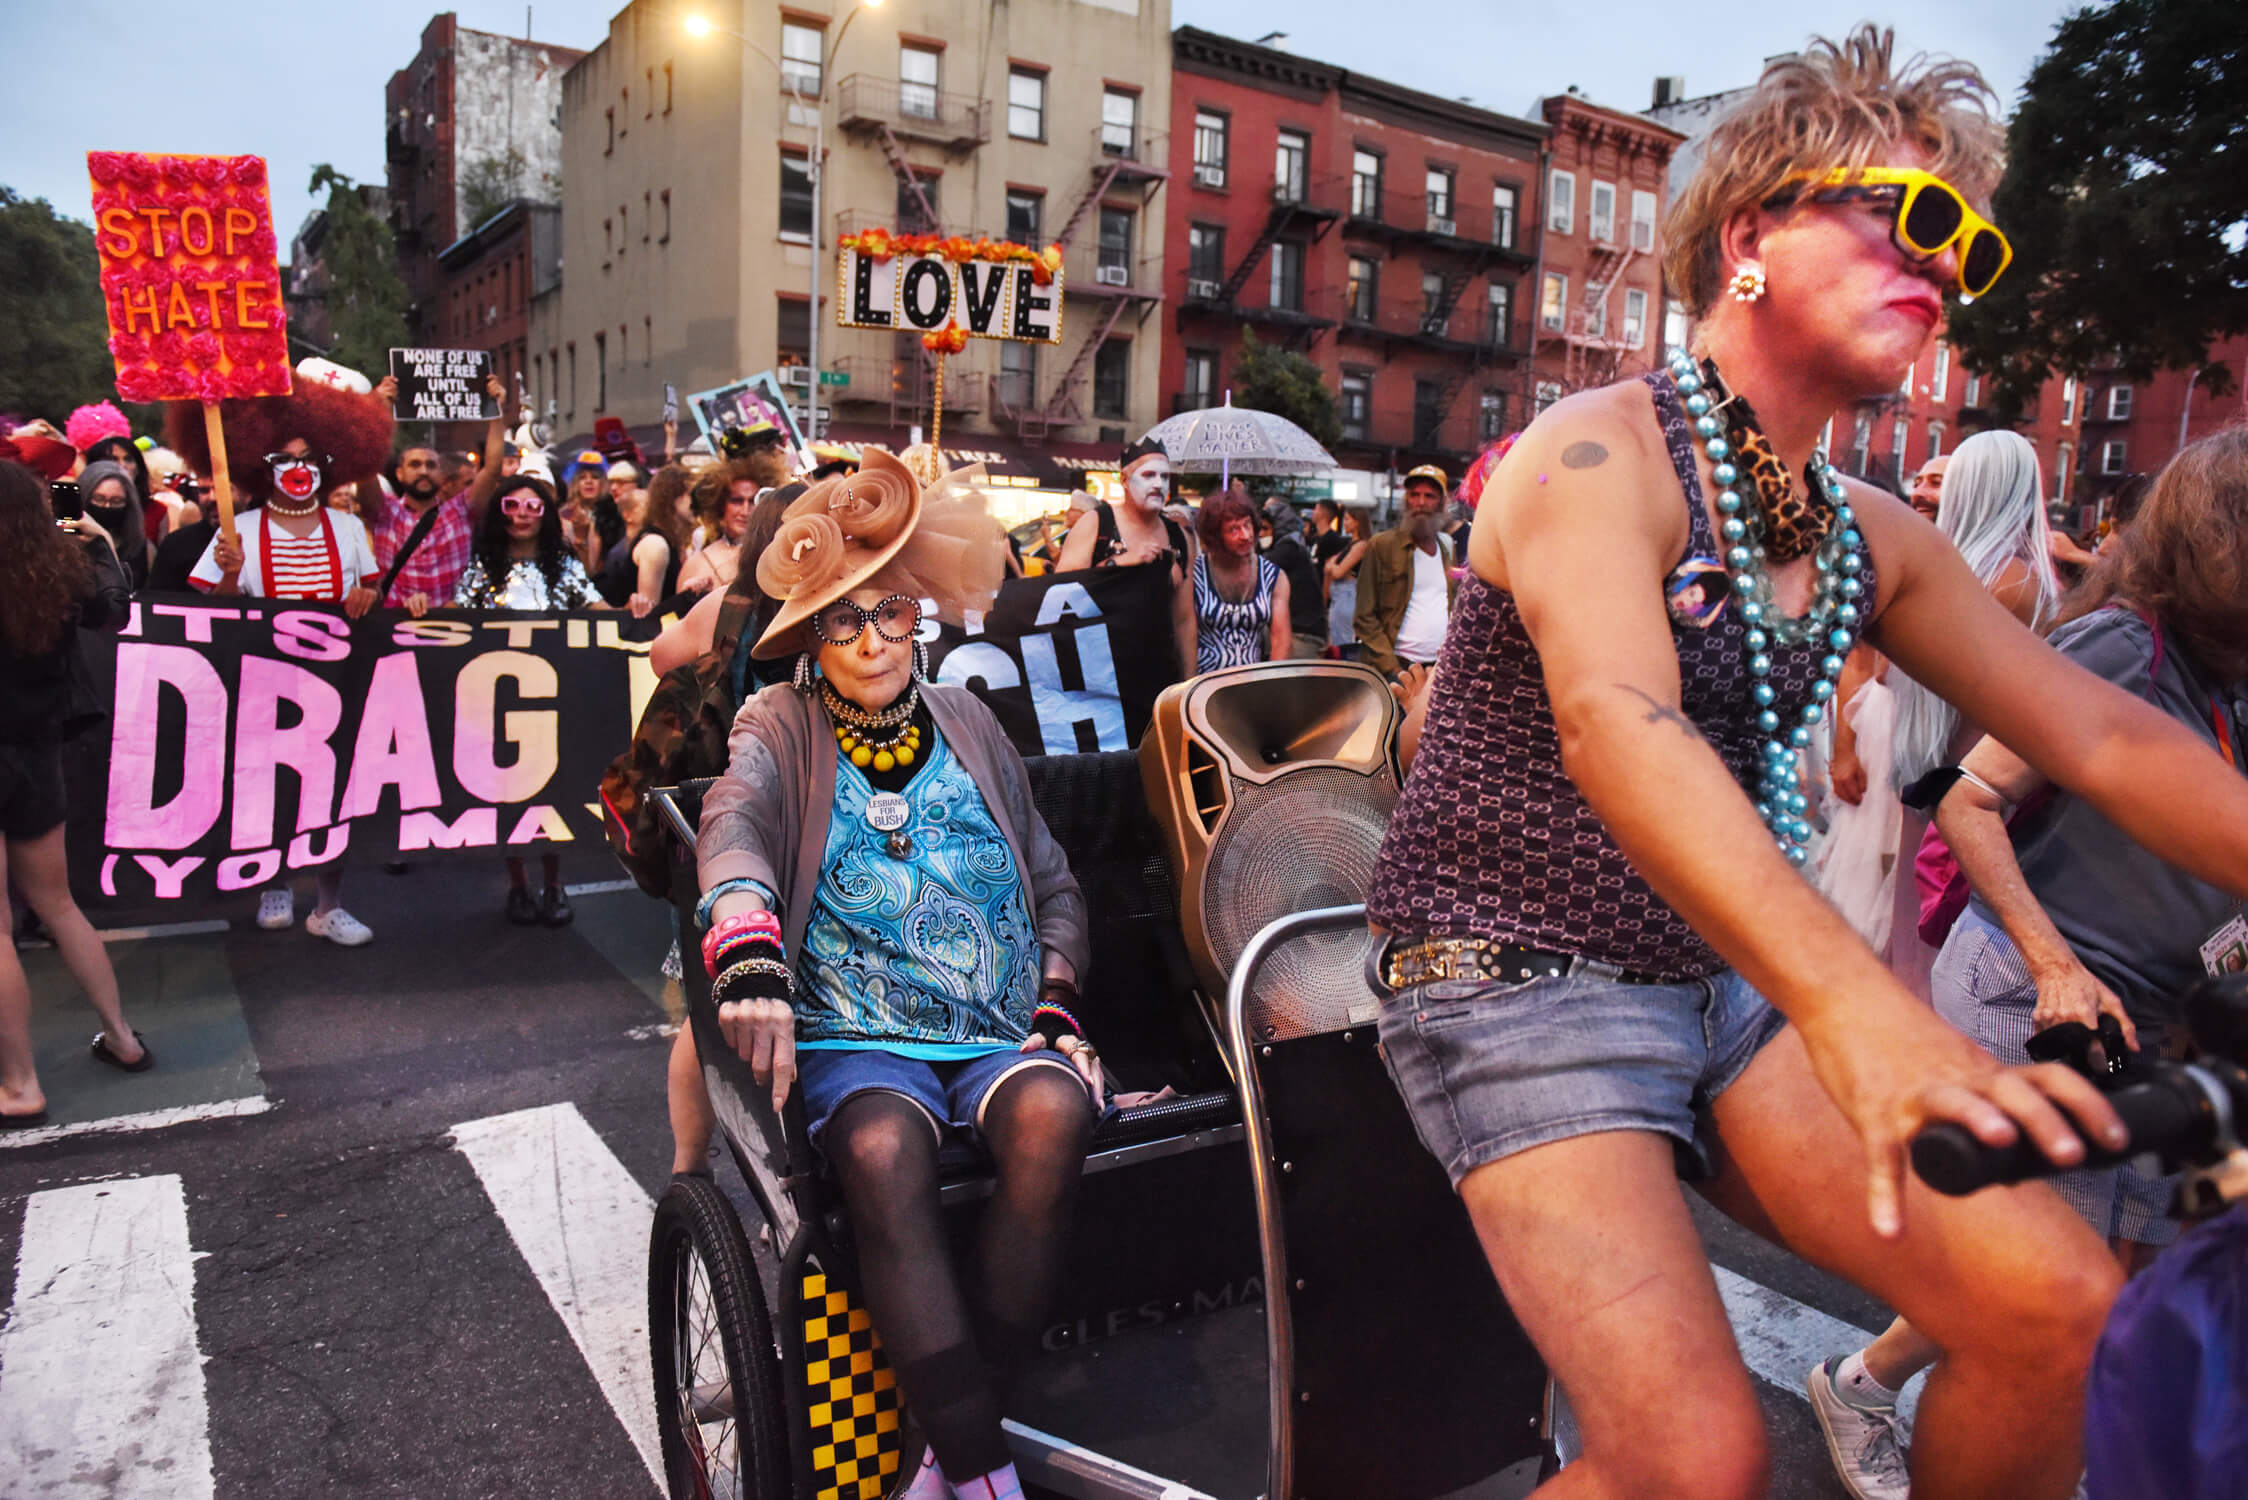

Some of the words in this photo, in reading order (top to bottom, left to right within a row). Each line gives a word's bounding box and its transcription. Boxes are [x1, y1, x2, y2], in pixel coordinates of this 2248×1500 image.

[102, 207, 257, 259] STOP
[853, 254, 1055, 339] LOVE
[122, 281, 269, 334] HATE
[403, 349, 445, 364] NONE
[447, 350, 464, 364] OF
[466, 351, 482, 365] US
[413, 364, 444, 377] ARE
[446, 364, 477, 378] FREE
[427, 378, 469, 392] UNTIL
[413, 392, 441, 406] ALL
[444, 392, 464, 405] OF
[465, 392, 481, 405] US
[416, 406, 446, 419] ARE
[448, 406, 482, 419] FREE
[1203, 430, 1255, 440] LIVES
[1198, 439, 1261, 453] MATTER
[117, 602, 351, 661] IT'S
[392, 611, 678, 652] STIL
[1034, 582, 1103, 626] A
[104, 642, 558, 850] DRAG
[868, 798, 905, 807] LESBIANS
[880, 807, 895, 815] FOR
[874, 815, 904, 826] BUSH
[101, 822, 350, 899] (YOU
[399, 803, 610, 850] MA
